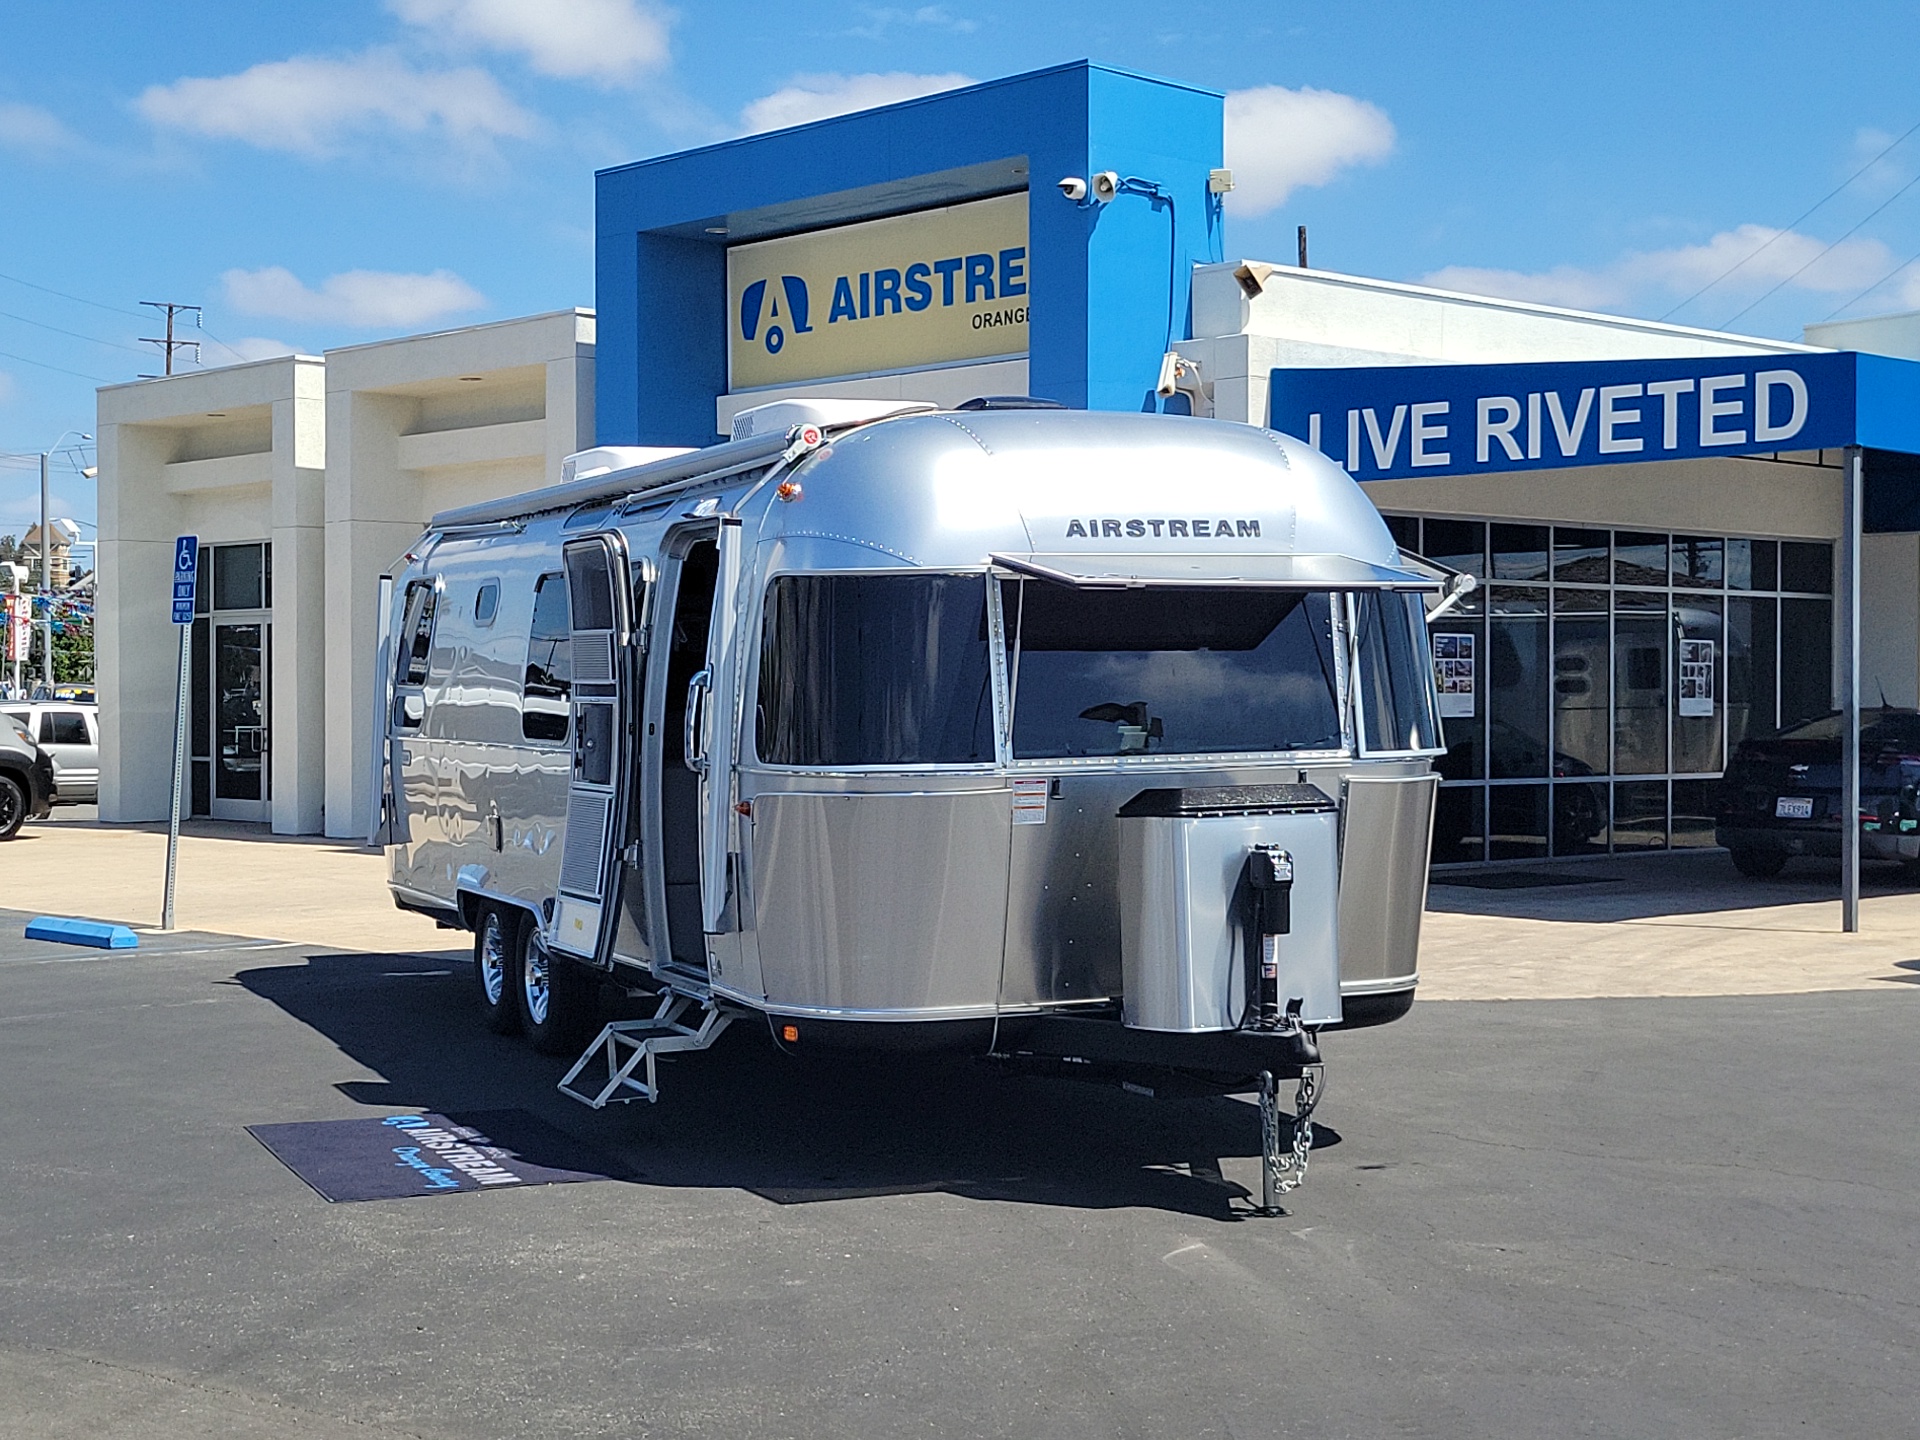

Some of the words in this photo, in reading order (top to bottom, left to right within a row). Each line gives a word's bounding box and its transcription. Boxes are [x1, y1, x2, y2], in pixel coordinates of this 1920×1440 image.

[828, 246, 1028, 324] AIRSTRE
[1308, 400, 1450, 473] LIVE
[1476, 369, 1810, 463] RIVETED
[1066, 518, 1261, 538] AIRSTREAM
[402, 1127, 523, 1185] AIRSTREAM
